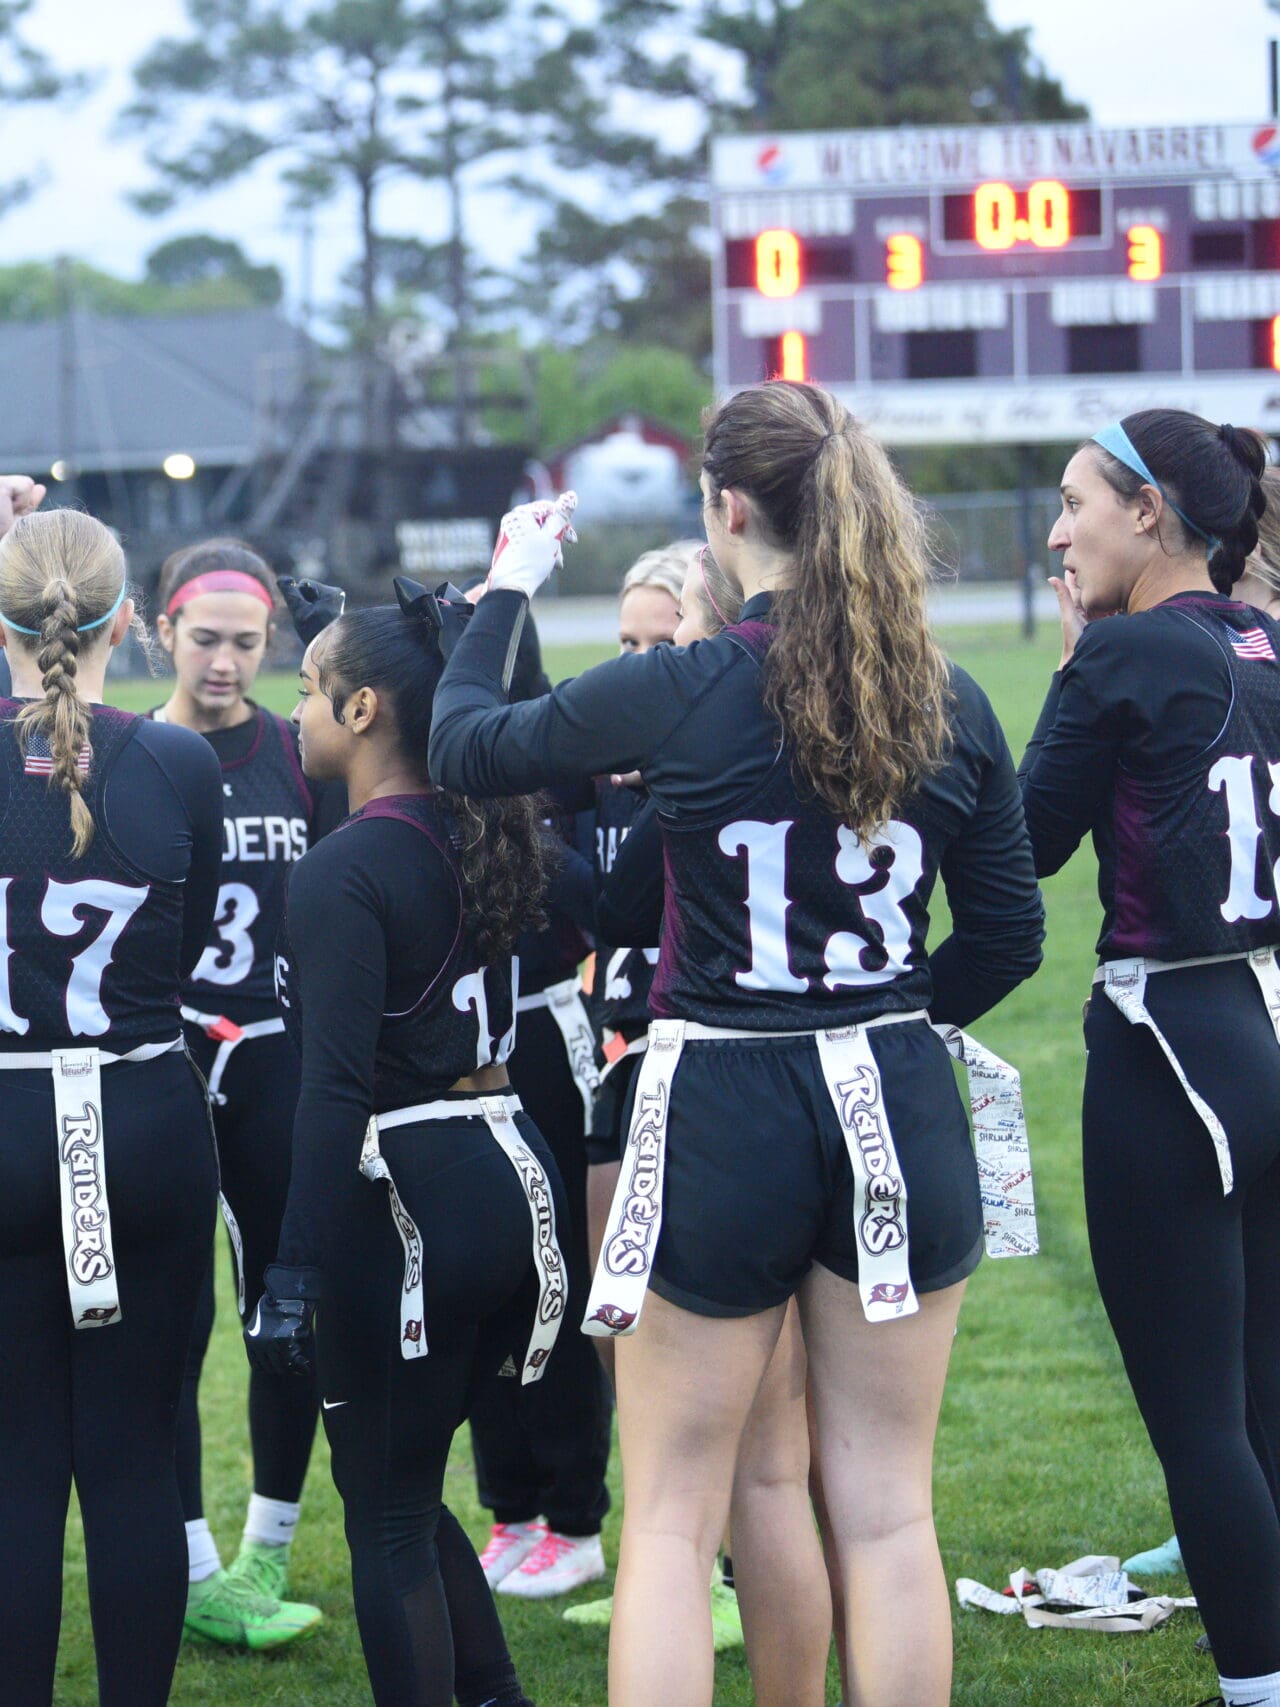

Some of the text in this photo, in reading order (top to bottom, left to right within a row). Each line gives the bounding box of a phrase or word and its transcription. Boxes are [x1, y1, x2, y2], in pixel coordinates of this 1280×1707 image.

[756, 230, 800, 298] 0
[887, 234, 923, 290] 3
[1127, 225, 1162, 281] 3
[718, 819, 924, 994] 13
